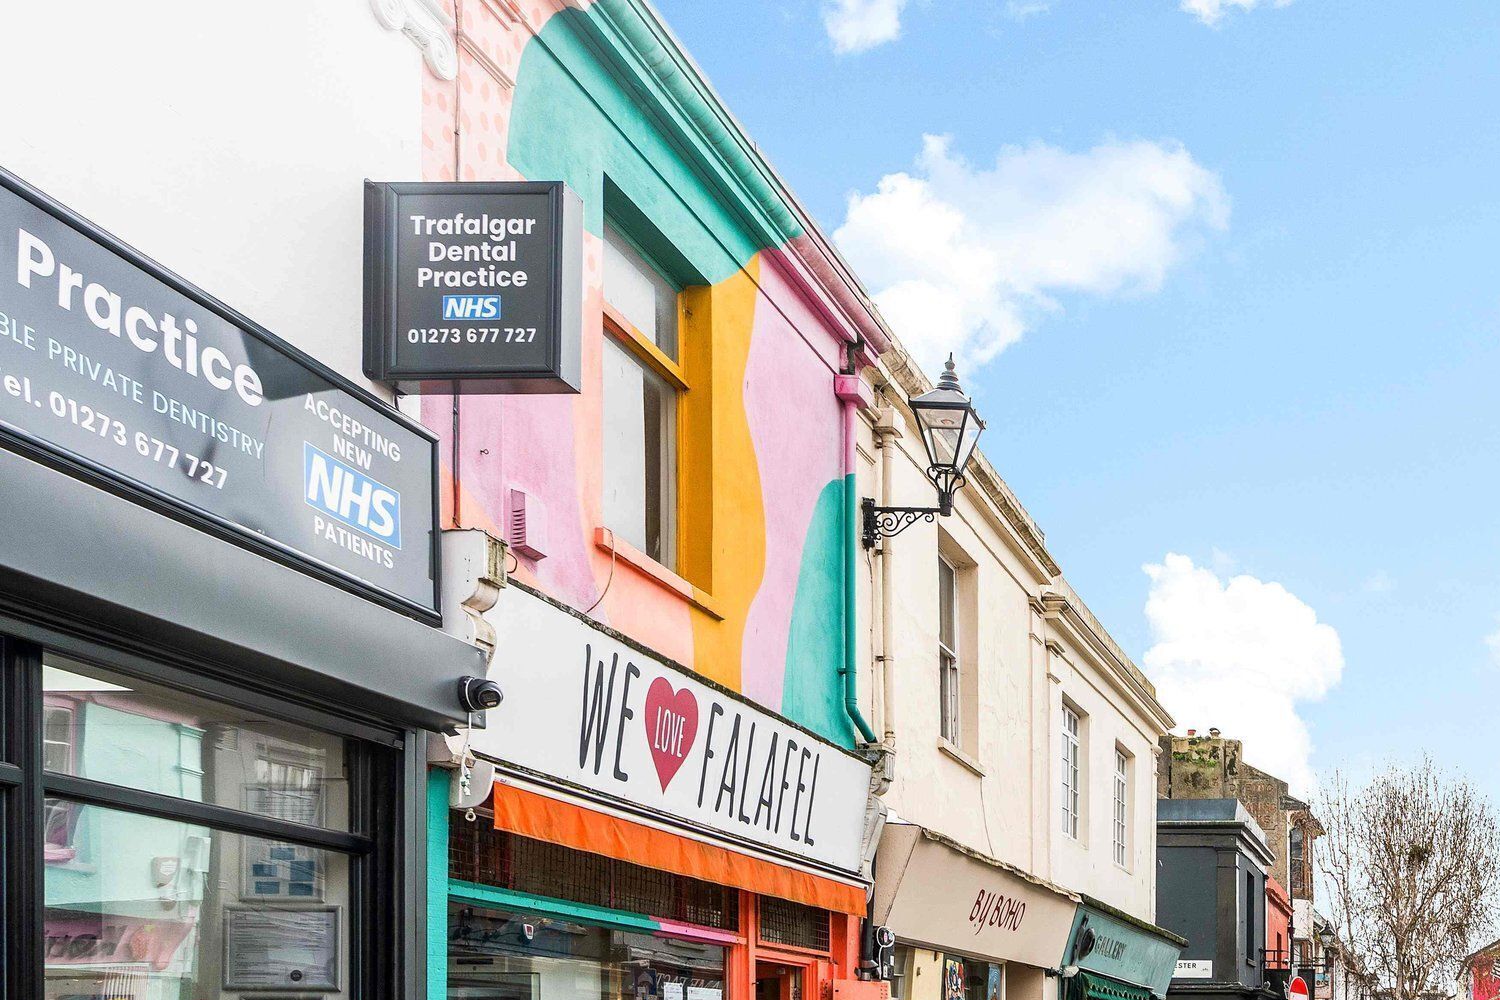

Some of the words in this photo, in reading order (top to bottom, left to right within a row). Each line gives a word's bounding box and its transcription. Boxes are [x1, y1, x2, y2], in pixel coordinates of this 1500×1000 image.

[410, 213, 536, 241] Trafalgar
[429, 241, 516, 262] Dental
[417, 265, 528, 288] Practice
[17, 228, 264, 407] Practice
[445, 297, 499, 318] NHS
[407, 328, 461, 344] 01273
[466, 328, 500, 343] 677
[504, 328, 537, 343] 727
[48, 337, 144, 404] PRIVATE
[153, 390, 265, 460] DENTISTRY
[49, 391, 128, 447] 01273
[135, 431, 181, 469] 677
[185, 453, 228, 490] 727
[304, 392, 401, 462] ACCEPTING
[333, 434, 373, 471] NEW
[307, 453, 396, 538] NHS
[314, 515, 394, 569] PATIENTS
[579, 643, 641, 782] WE
[654, 706, 687, 758] LOVE
[697, 702, 821, 847] FALAFEL
[989, 894, 1026, 932] BOHO
[1094, 934, 1127, 962] GALLERY
